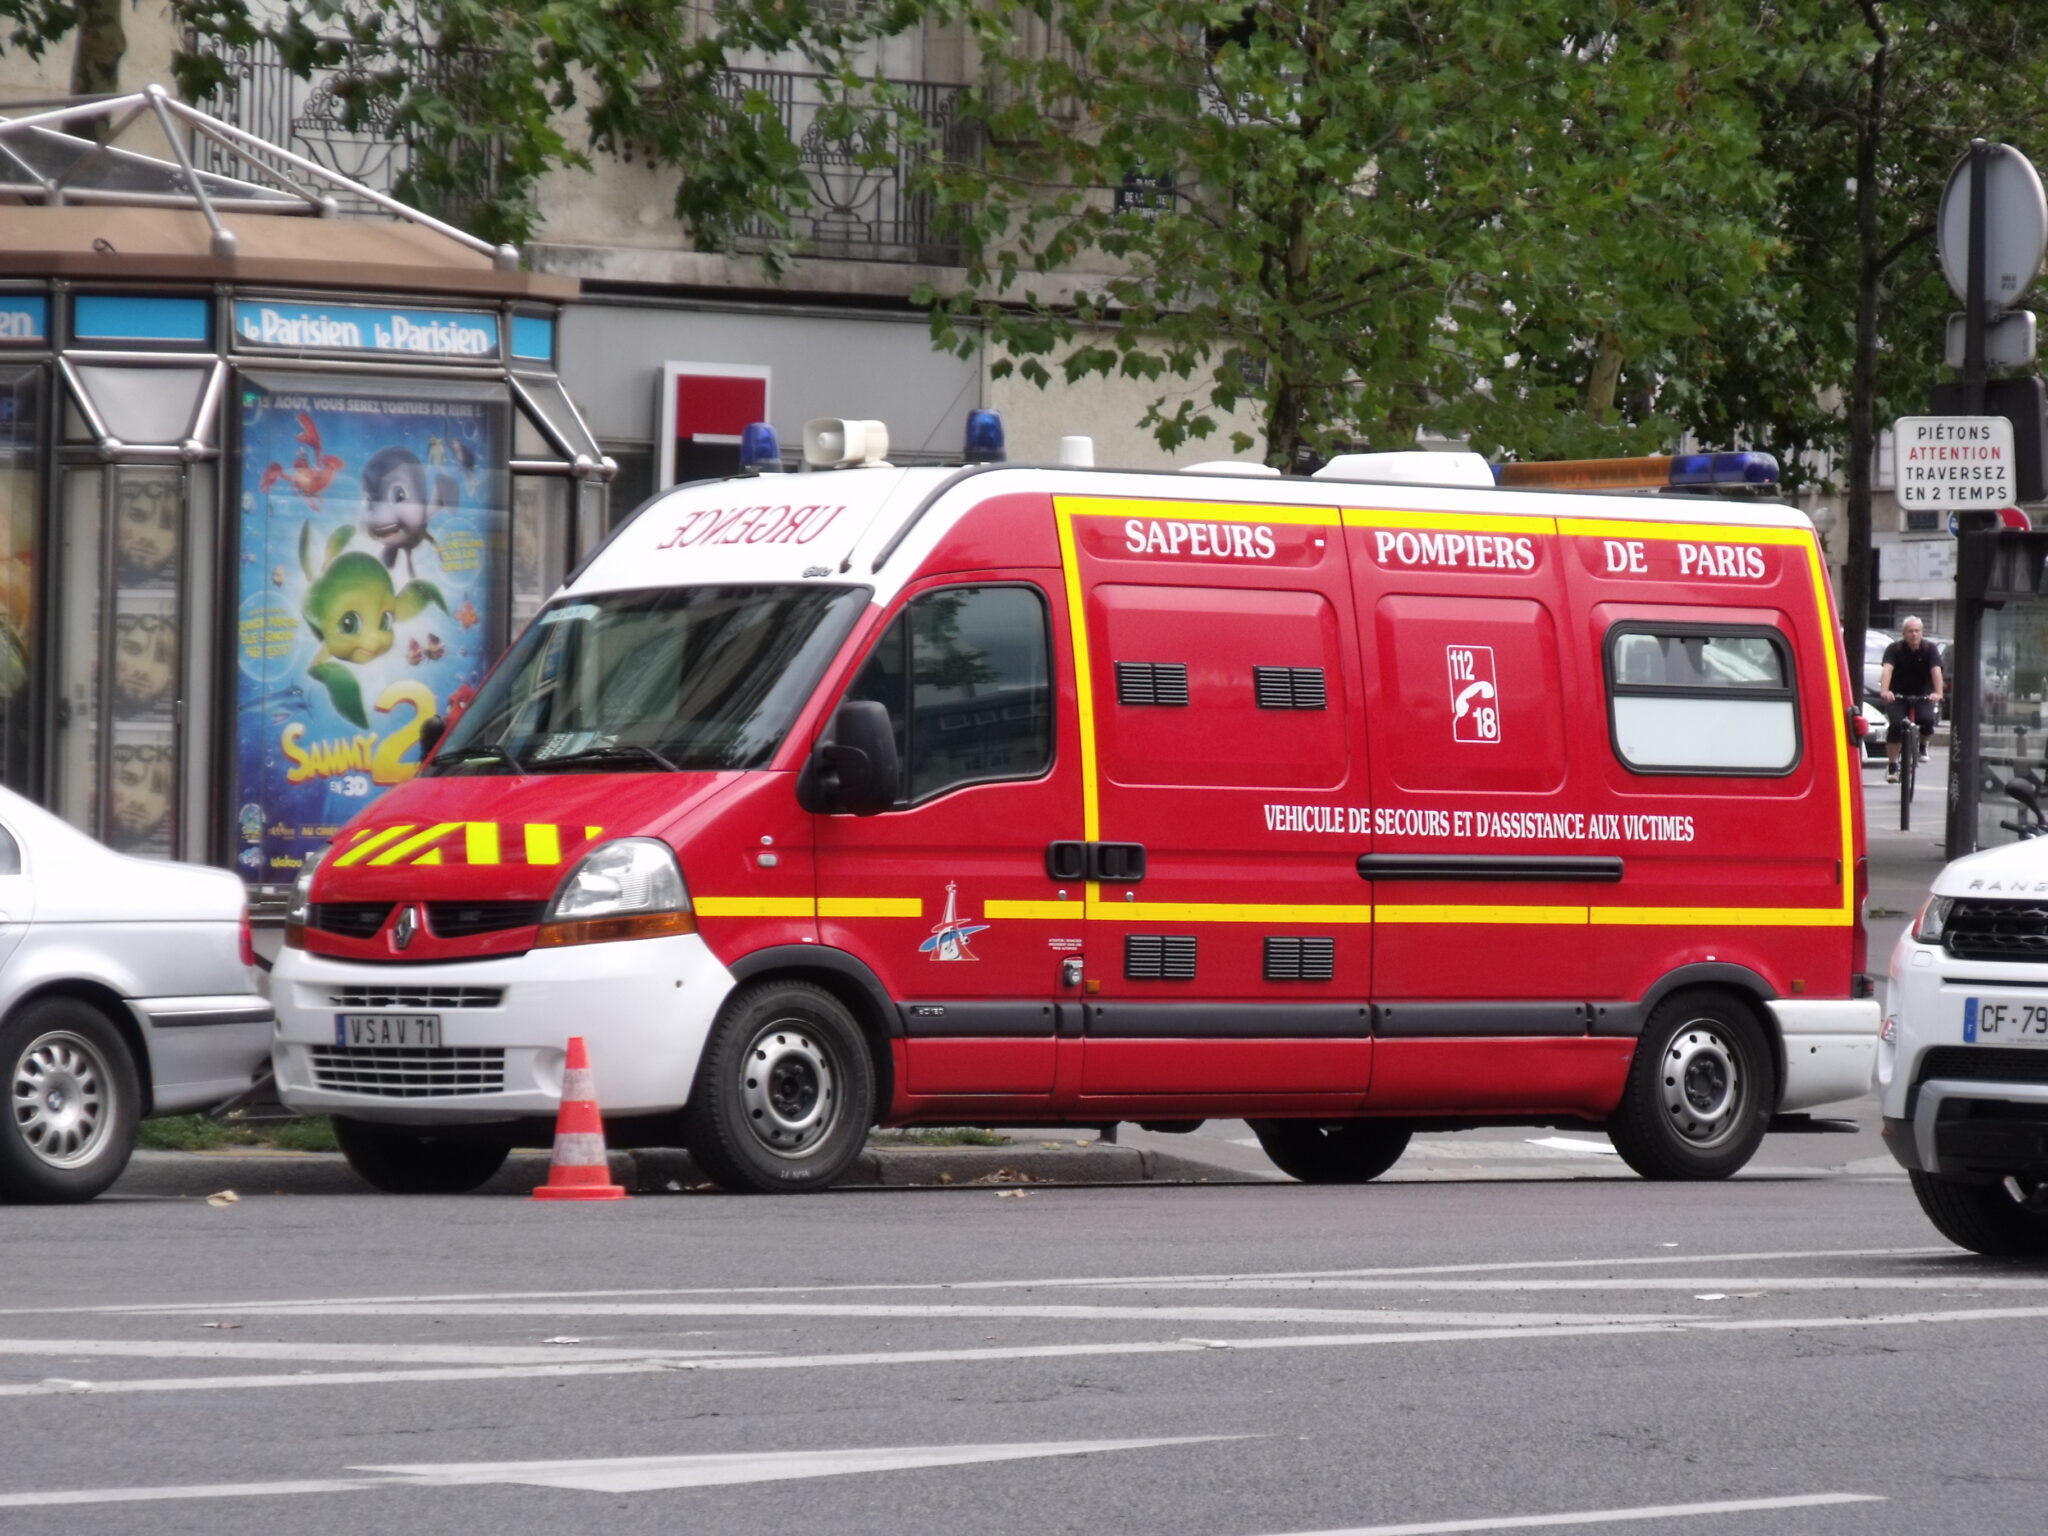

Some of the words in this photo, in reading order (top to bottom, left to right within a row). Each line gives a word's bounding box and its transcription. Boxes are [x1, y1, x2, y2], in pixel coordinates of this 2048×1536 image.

[261, 308, 360, 347] Parisien
[391, 315, 487, 354] Parisien
[314, 398, 345, 410] VOUS
[432, 403, 446, 415] DE
[1918, 424, 1990, 440] PIÉTONS
[1909, 446, 2001, 460] ATTENTION
[1906, 466, 2006, 480] TRAVERSEZ
[1905, 487, 1925, 500] EN
[1932, 486, 1941, 500] 2
[1948, 486, 2007, 500] TEMPS
[1125, 519, 1276, 559] SAPEURS
[1374, 531, 1535, 570] POMPIERS
[1604, 541, 1648, 573] DE
[1677, 543, 1766, 579] PARIS
[1450, 650, 1475, 680] 112
[373, 680, 436, 786] 2
[1472, 707, 1497, 738] 18
[344, 776, 369, 797] 3D
[1263, 804, 1345, 833] VEHICULE
[1348, 807, 1371, 834] DE
[1374, 808, 1450, 837] SECOURS
[1453, 811, 1473, 837] ET
[1476, 811, 1585, 839] D'ASSISTANCE
[1588, 814, 1620, 840] AUX
[1622, 815, 1694, 842] VICTIMES
[351, 1018, 406, 1044] VSAV
[415, 1018, 434, 1044] 71
